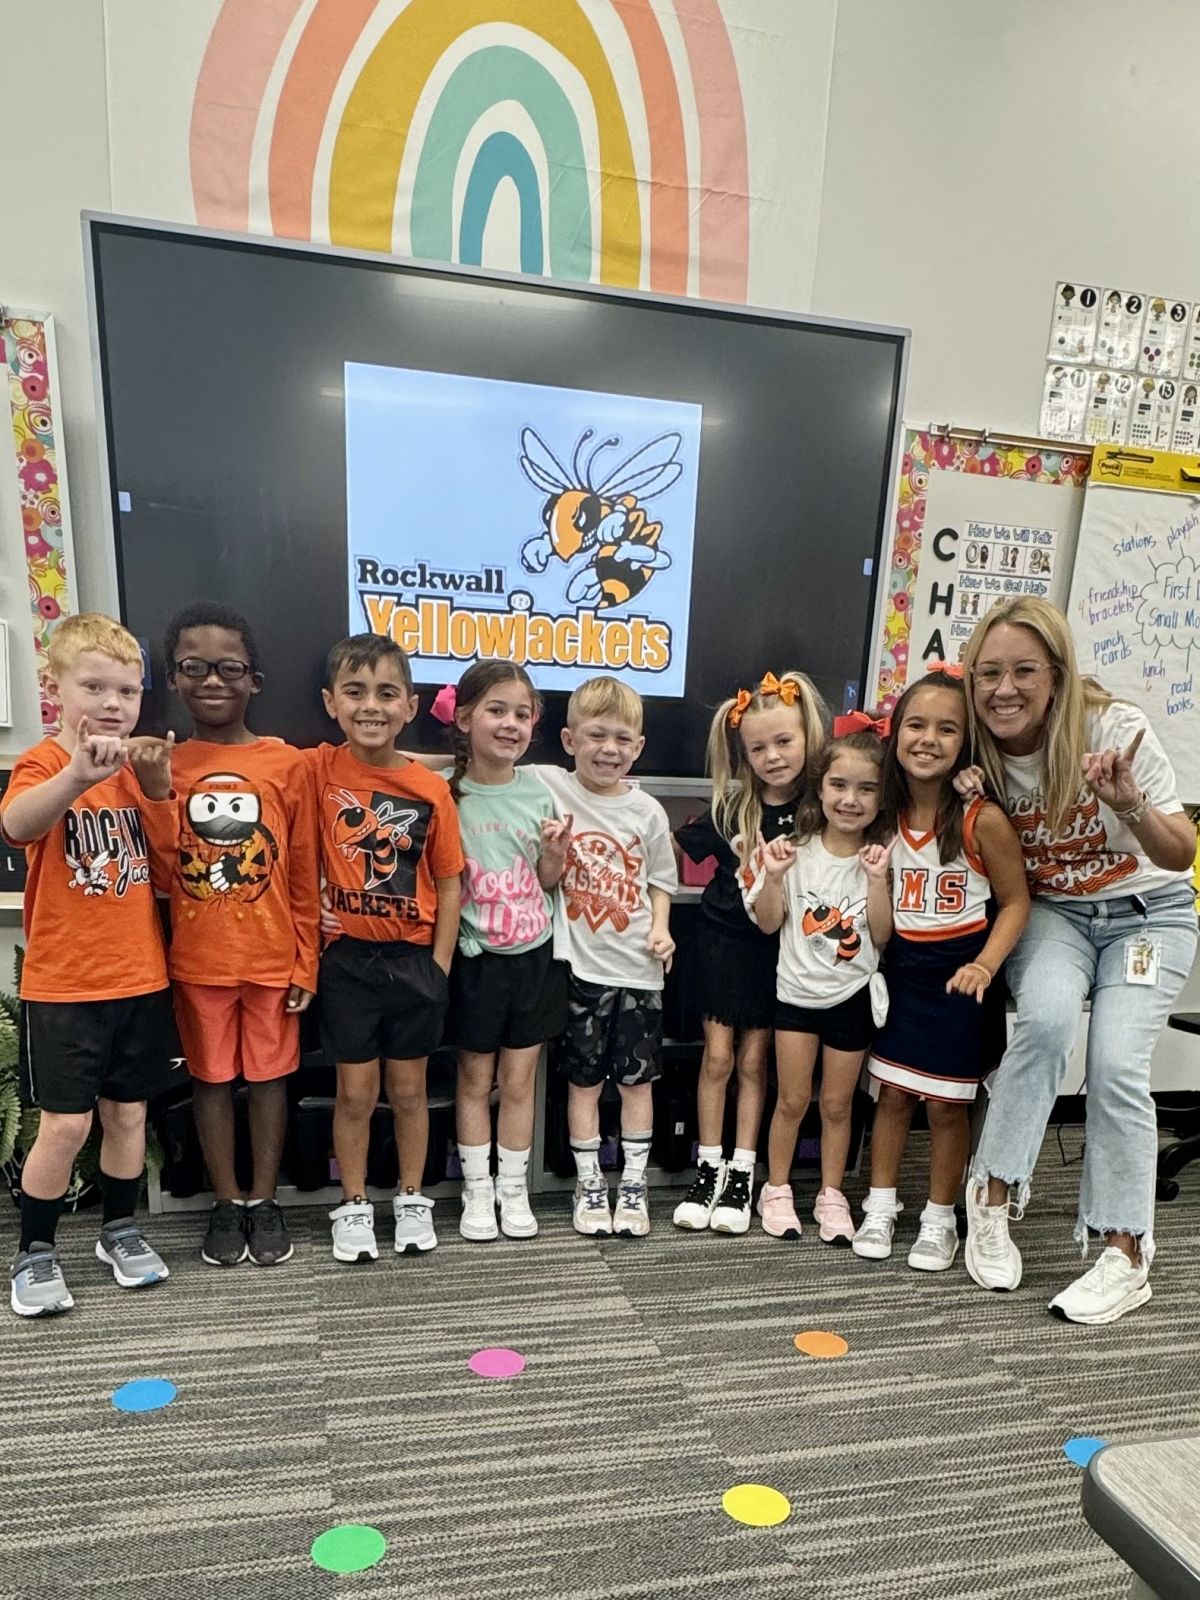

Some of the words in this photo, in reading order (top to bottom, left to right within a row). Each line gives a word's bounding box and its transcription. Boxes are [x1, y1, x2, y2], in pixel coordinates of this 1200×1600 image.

[1047, 431, 1075, 442] eleven
[933, 527, 959, 562] C
[967, 523, 992, 538] How
[994, 525, 1011, 541] We
[1013, 527, 1030, 543] Will
[1031, 530, 1053, 545] Talk
[966, 542, 978, 563] 0
[1000, 546, 1010, 567] 1
[1113, 535, 1157, 557] stations
[1029, 549, 1043, 570] 2
[357, 559, 505, 594] Rockwall
[959, 575, 982, 590] How
[984, 576, 1001, 591] We
[1003, 578, 1022, 592] Get
[1024, 580, 1048, 597] Help
[1163, 576, 1191, 600] First
[929, 581, 954, 617] H
[1088, 580, 1138, 605] friendship
[1088, 600, 1135, 626] bracelets
[1149, 606, 1178, 629] Small
[361, 590, 672, 671] Yellowjackets
[950, 623, 972, 637] How
[922, 628, 945, 661] A
[1093, 630, 1125, 660] punch
[1101, 642, 1132, 666] cards
[1142, 659, 1166, 678] lunch
[1171, 674, 1193, 696] read
[1166, 697, 1194, 715] books
[7, 856, 16, 872] L
[114, 848, 151, 898] Jac
[461, 855, 535, 903] Rock
